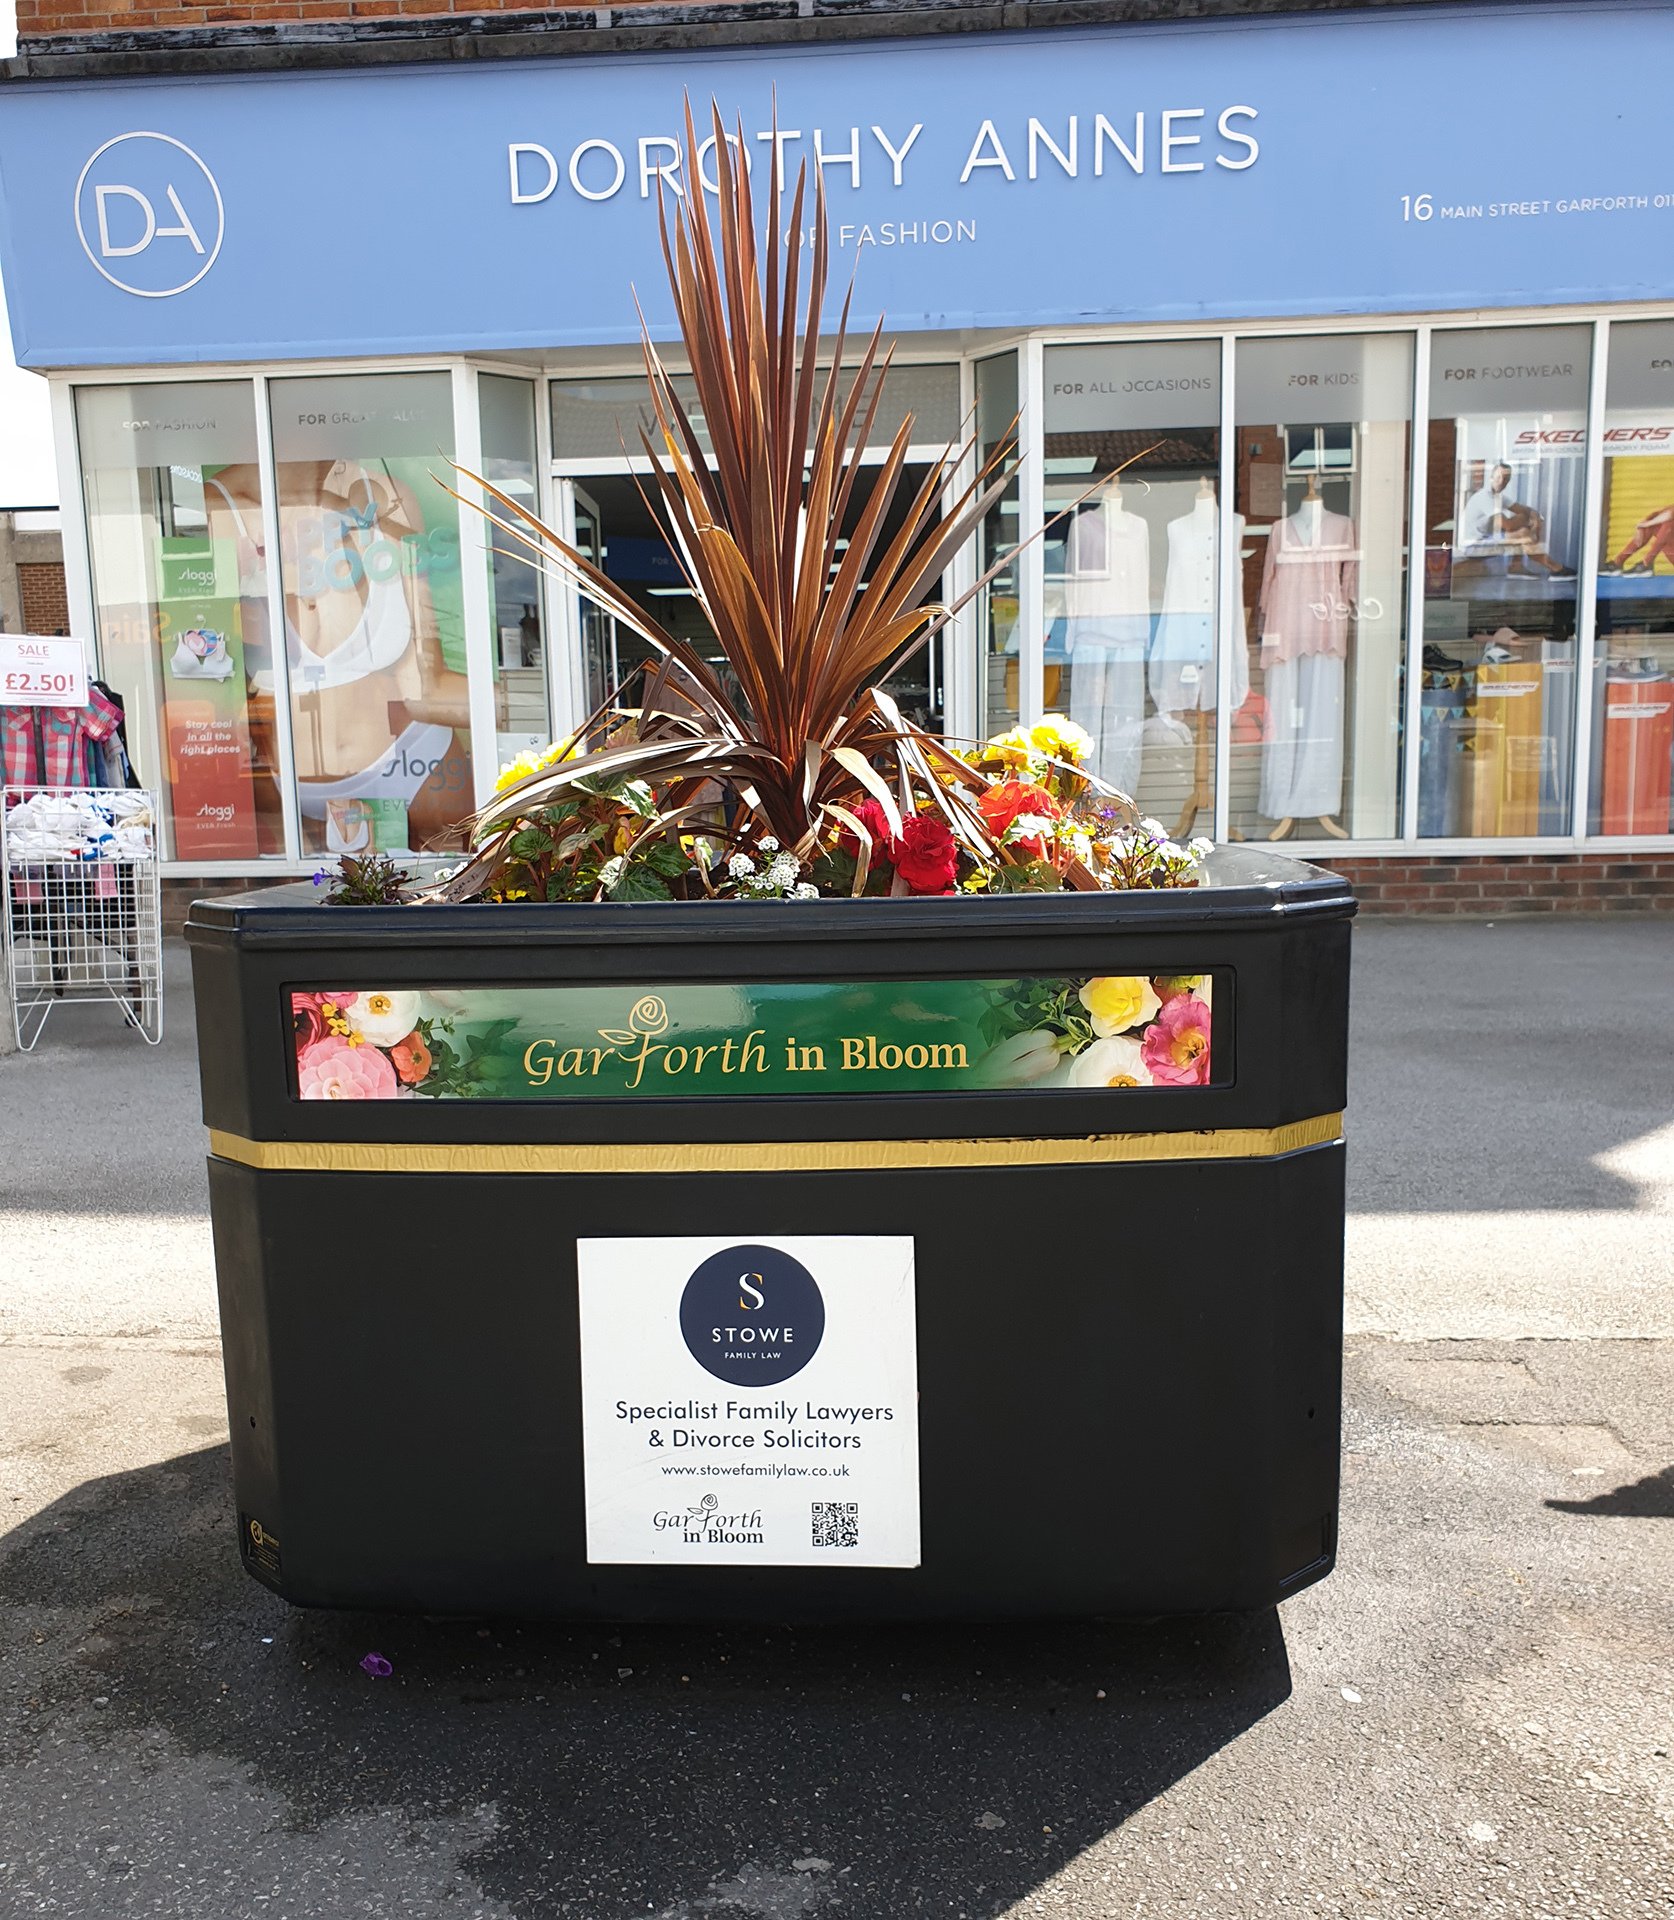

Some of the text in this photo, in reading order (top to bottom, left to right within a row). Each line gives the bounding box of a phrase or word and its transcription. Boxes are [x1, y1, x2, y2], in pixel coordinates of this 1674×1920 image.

[508, 105, 1261, 205] DOROTHY ANNES
[1400, 193, 1434, 222] 16
[1440, 204, 1483, 219] MAIN
[1488, 200, 1552, 217] STREET
[1555, 195, 1649, 214] GARFORTH
[95, 183, 206, 258] DA
[839, 219, 977, 249] FASHION
[1444, 363, 1573, 381] FOR FOOTWEAR
[1650, 358, 1674, 370] FO
[1053, 377, 1212, 396] FOR ALL OCCASIONS
[1287, 372, 1359, 387] FOR KIDS
[298, 413, 327, 426] FOR
[18, 644, 50, 656] SALE
[5, 672, 74, 692] £2.50!
[184, 719, 233, 731] Stay cool
[187, 731, 232, 742] in all the
[180, 745, 241, 757] right places
[381, 749, 472, 792] sloggi
[196, 803, 235, 821] sloggi
[523, 1018, 970, 1089] Garforth in Bloom
[738, 1272, 766, 1311] S
[711, 1326, 795, 1344] STOWE
[724, 1351, 782, 1360] FAMILY LAW
[615, 1400, 894, 1425] Specialist Family Lawyers
[648, 1429, 862, 1450] & Divorce Solicitors
[661, 1463, 850, 1479] www.stowefamilylaw.co.uk
[652, 1504, 764, 1534] Garforth
[682, 1528, 765, 1545] in Bloom
